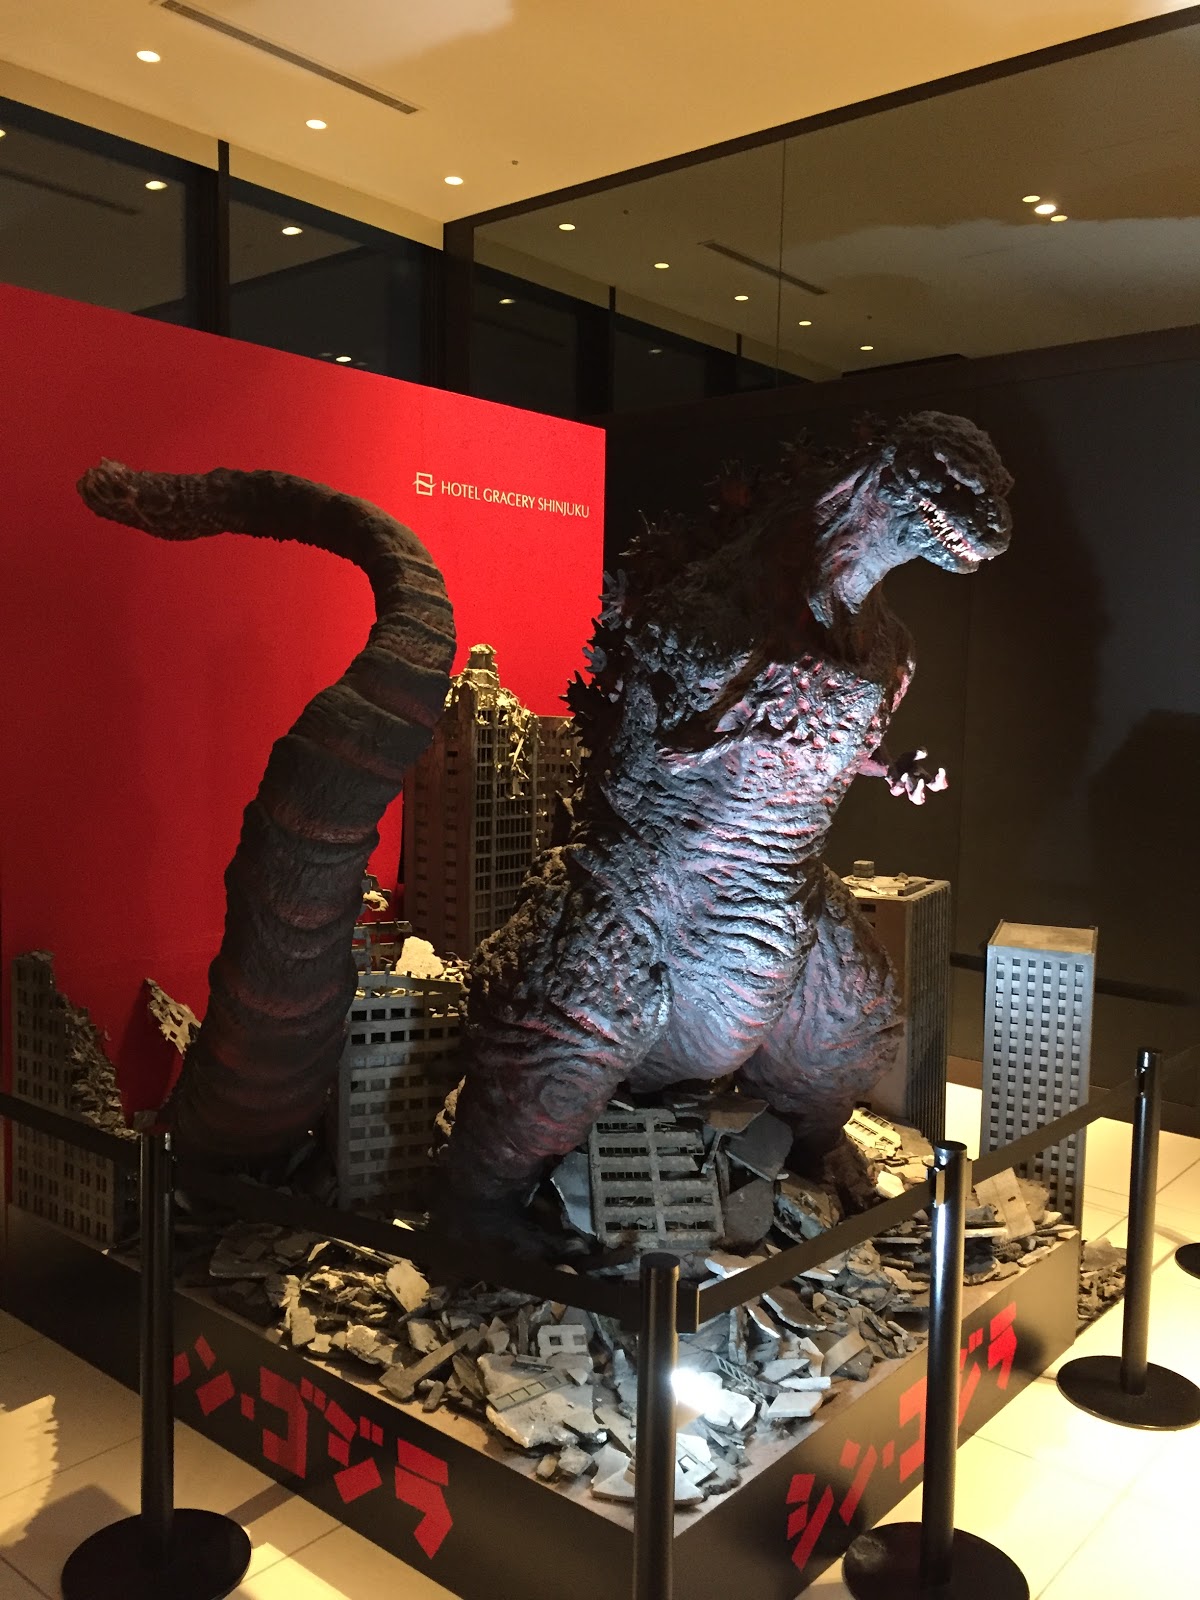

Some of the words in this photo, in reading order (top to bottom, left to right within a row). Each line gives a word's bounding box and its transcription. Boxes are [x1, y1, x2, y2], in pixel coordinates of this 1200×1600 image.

[440, 480, 481, 501] HOTEL
[482, 487, 536, 510] GRACERY
[537, 496, 590, 519] SHINJUKU
